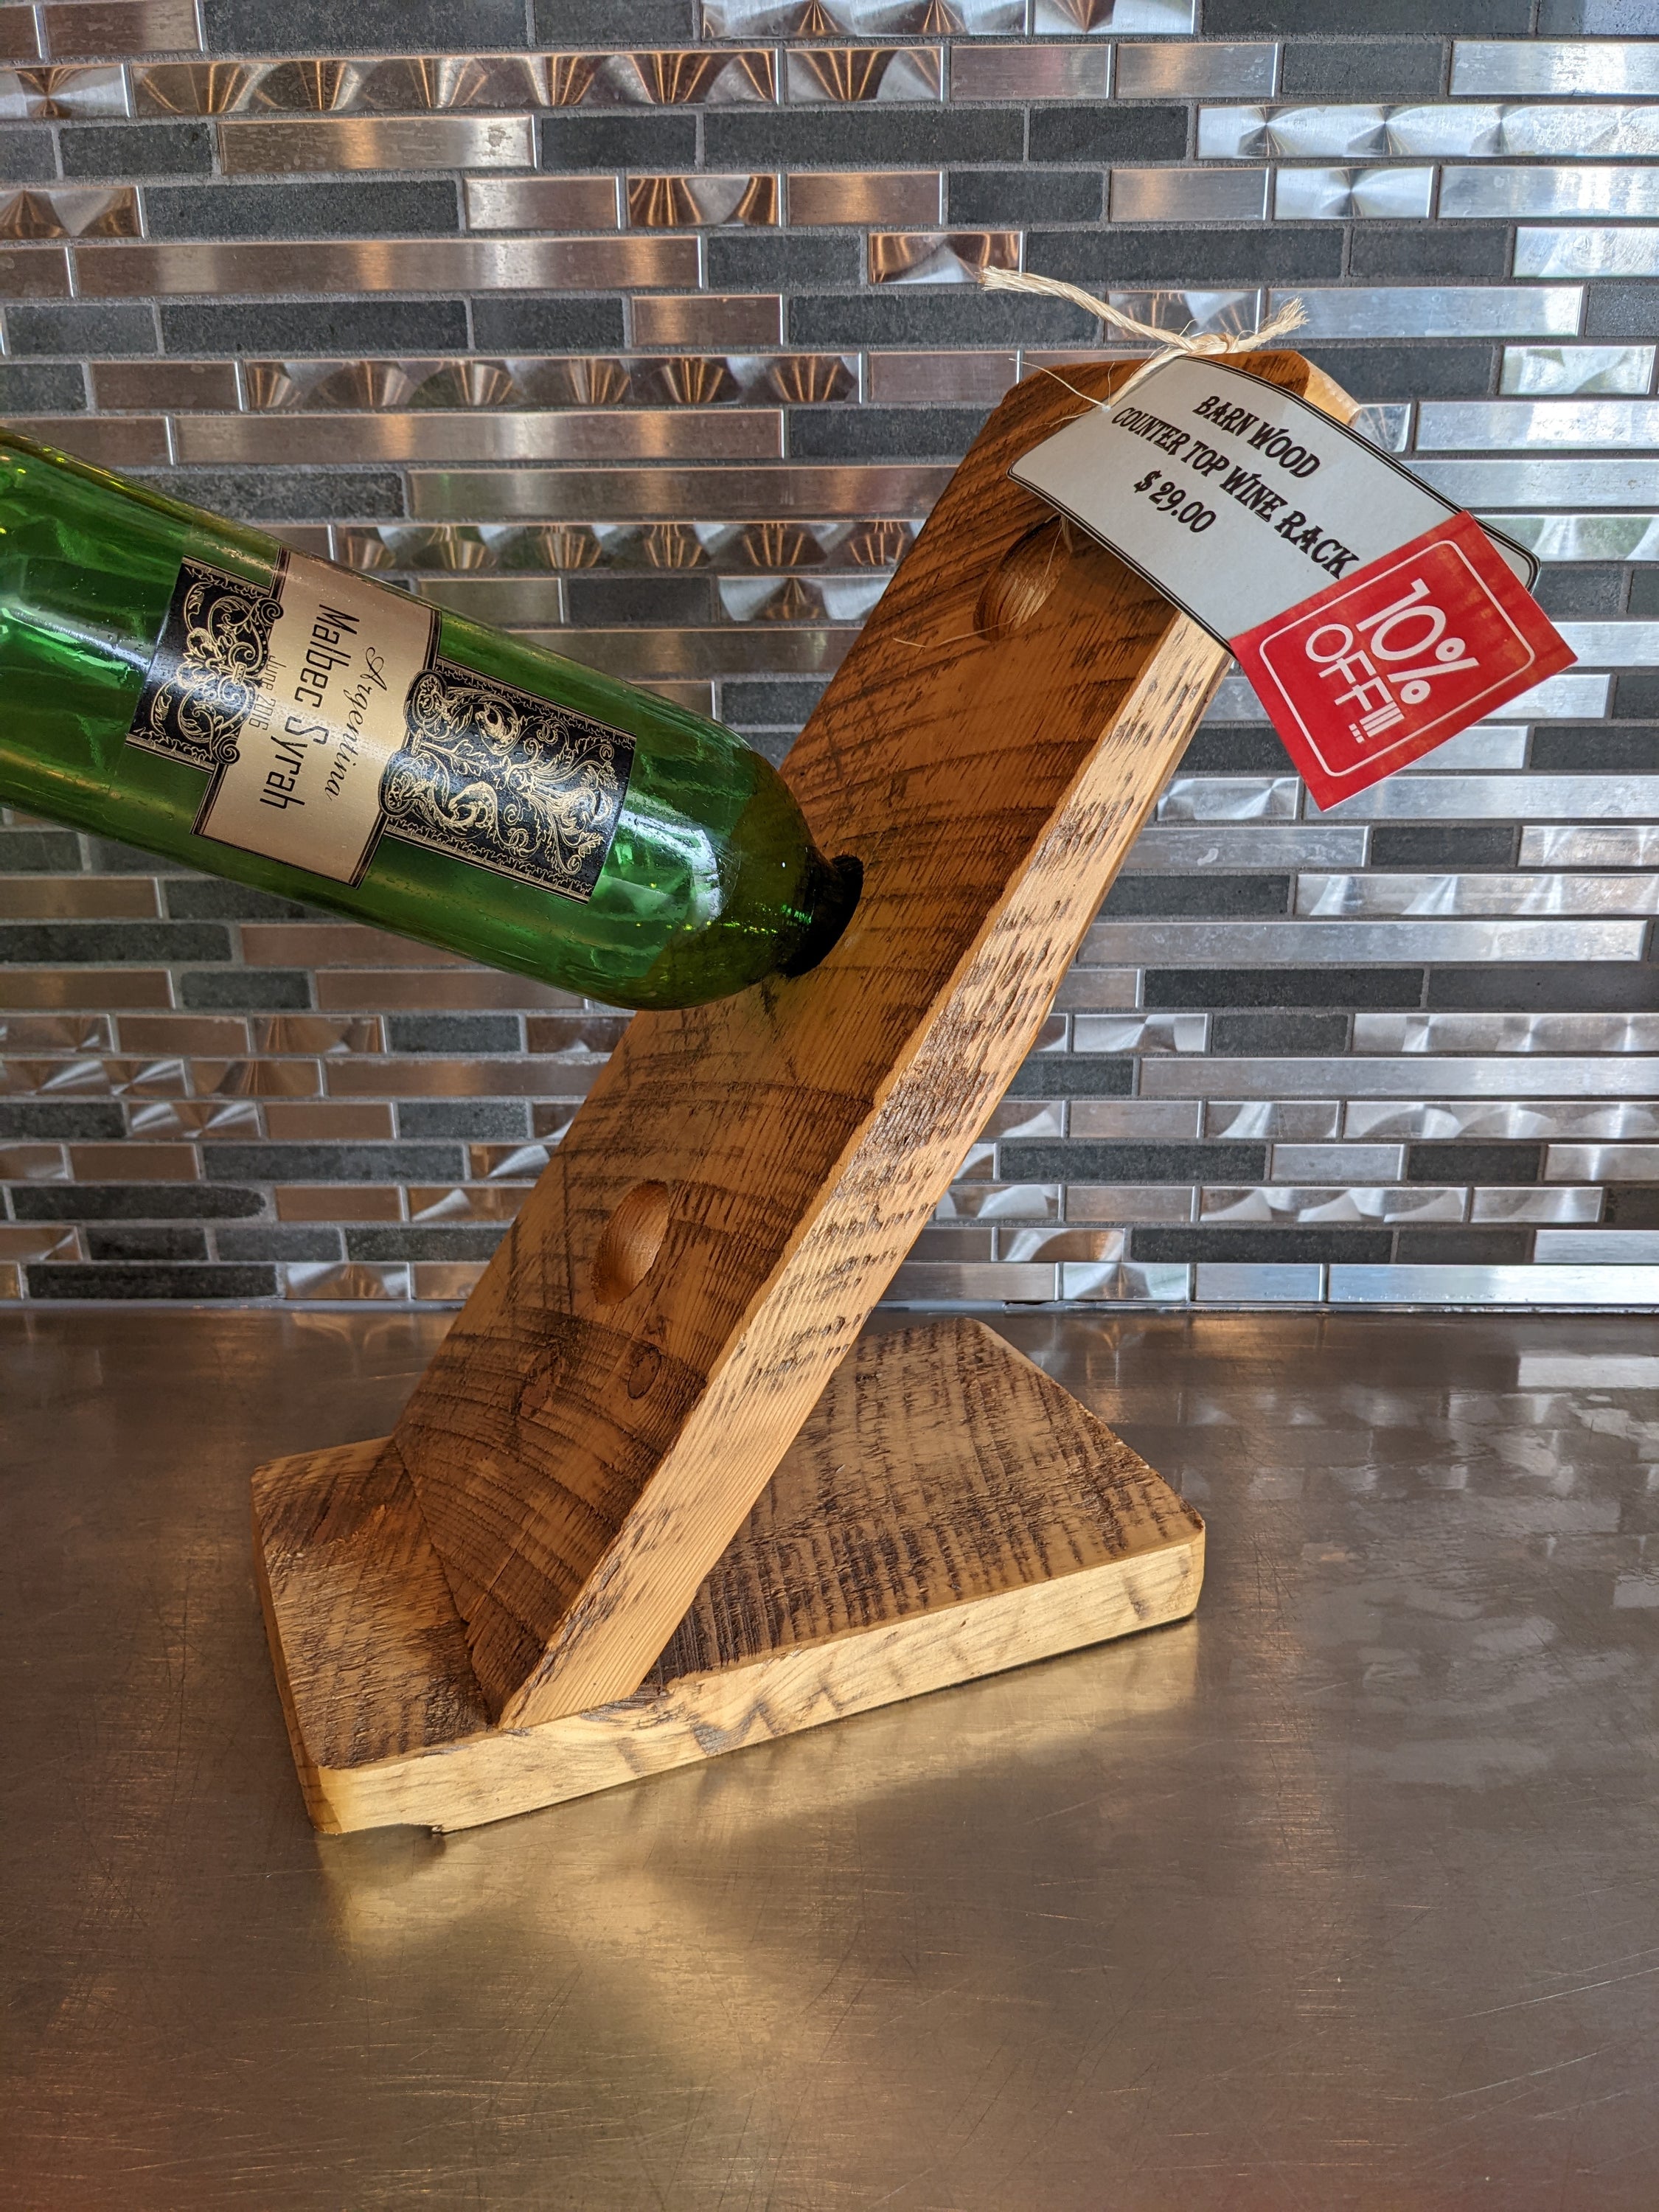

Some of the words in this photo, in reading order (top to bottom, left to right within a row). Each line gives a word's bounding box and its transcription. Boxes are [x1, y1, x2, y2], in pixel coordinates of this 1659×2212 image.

[1192, 396, 1259, 437] BARN
[1247, 422, 1321, 478] WOOD
[1111, 407, 1190, 456] COUNTER
[1180, 440, 1229, 477] TOP
[1220, 465, 1288, 523] WINE
[1273, 510, 1360, 580] RACK
[262, 655, 287, 690] June
[295, 604, 360, 708] Malbec
[1305, 623, 1405, 743] OFF!!!
[1356, 578, 1480, 704] 10%
[248, 694, 276, 730] 2016
[260, 716, 330, 809] Syrah
[324, 647, 387, 801] Argentina
